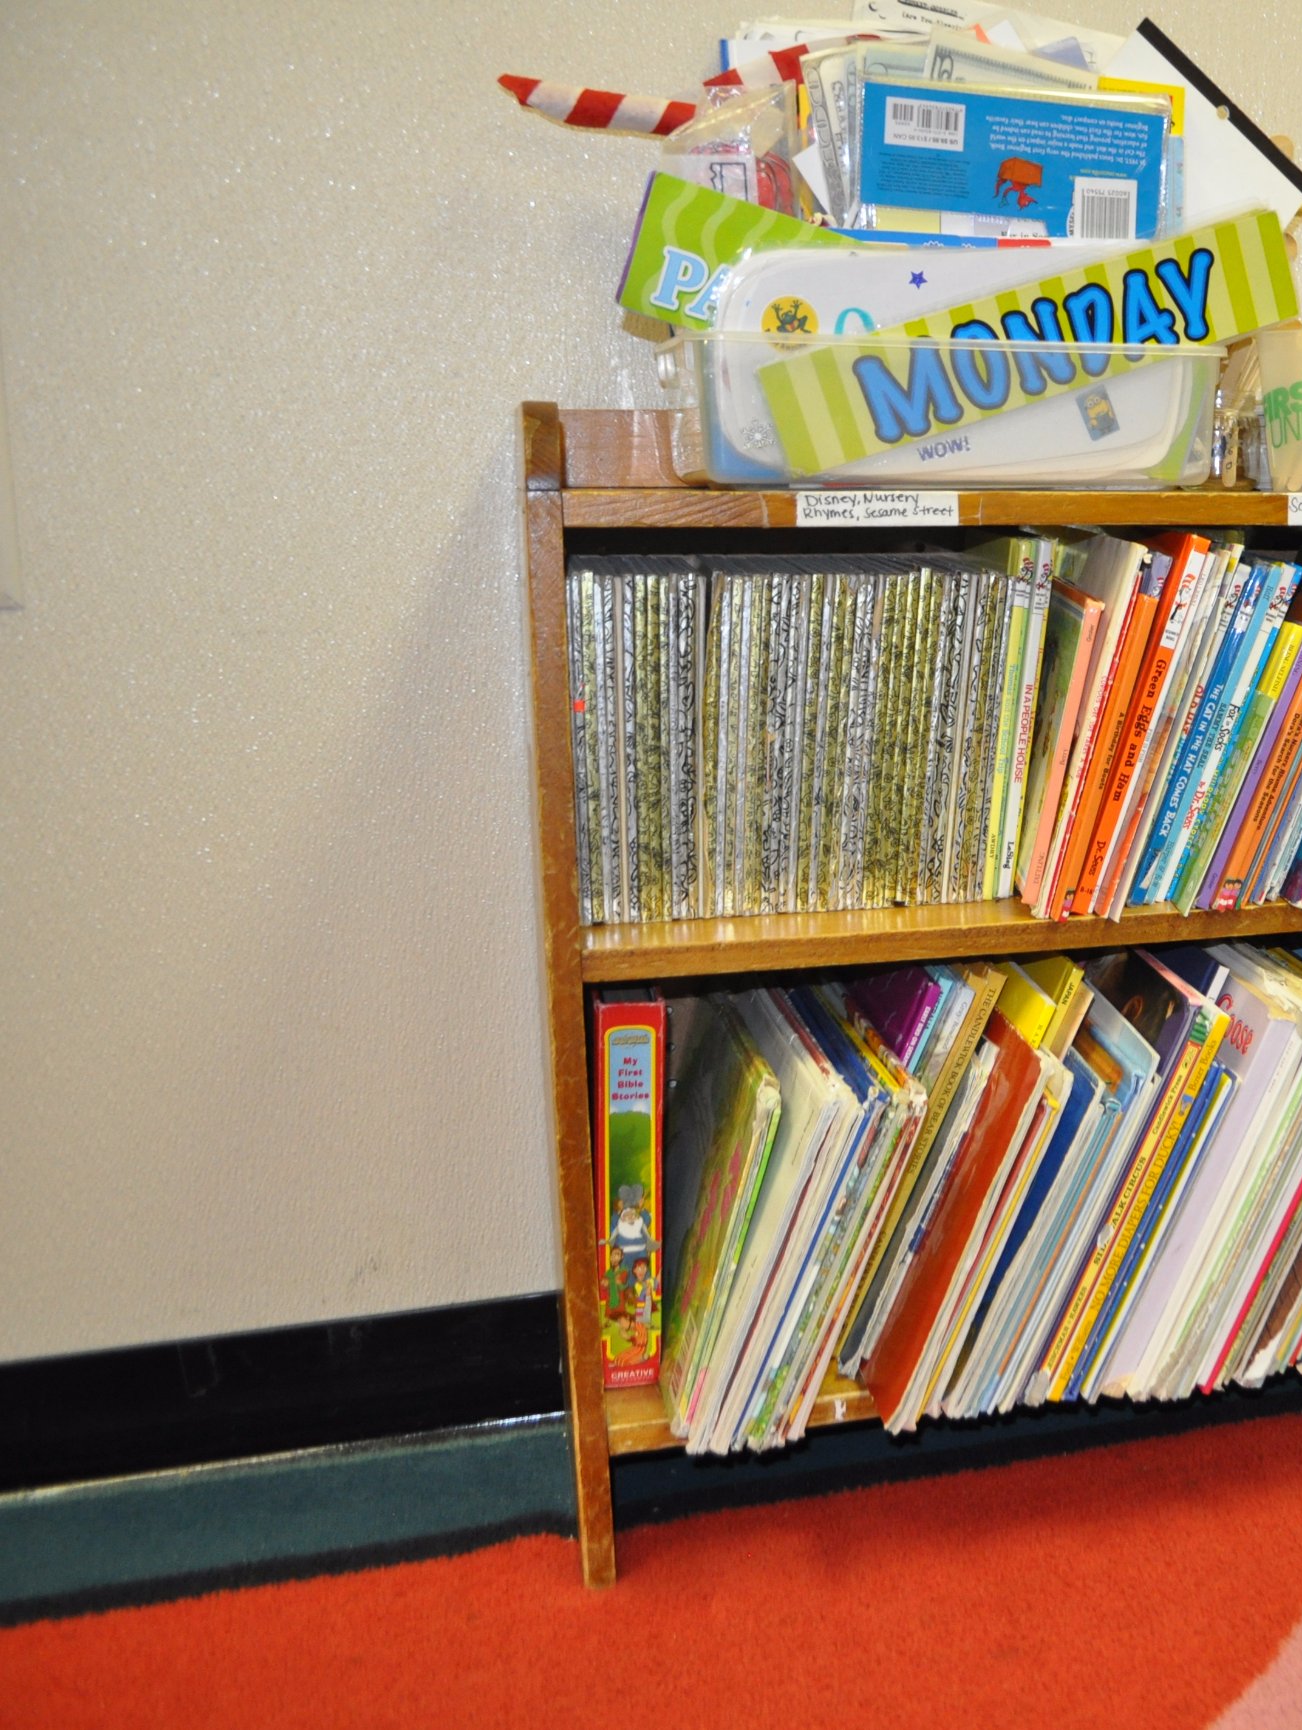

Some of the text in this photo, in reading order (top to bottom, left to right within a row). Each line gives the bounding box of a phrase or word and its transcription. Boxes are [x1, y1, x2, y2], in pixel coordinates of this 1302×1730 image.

[853, 248, 1214, 443] MONDAY
[916, 436, 971, 463] WOW!
[863, 506, 909, 519] Sesame
[912, 504, 955, 518] Street
[1024, 684, 1032, 694] IN
[1144, 658, 1167, 699] Green
[1018, 704, 1030, 745] PEOPLE
[1131, 704, 1152, 738] Eggs
[1224, 703, 1240, 721] Fox
[1108, 719, 1122, 752] Birthday
[1211, 725, 1231, 752] Socks
[1014, 747, 1026, 783] HOUSE
[1104, 754, 1113, 765] for
[1122, 742, 1140, 768] and
[1157, 682, 1224, 837] THE CAT IN THE HAT COMES BACK
[1196, 749, 1209, 770] SEAL
[1280, 738, 1297, 768] Nursery
[1098, 767, 1109, 790] Boots
[1251, 712, 1300, 823] Dora's Search for the Seasons
[1270, 768, 1286, 794] Rhyme
[1110, 771, 1130, 803] Ham
[1192, 788, 1205, 804] Dr.
[1182, 804, 1199, 830] Seuss
[1255, 794, 1276, 831] Adventure
[1003, 840, 1015, 869] LeSieg
[1088, 840, 1105, 877] Dr. Seuss
[1059, 982, 1076, 1006] JAPAN
[617, 1068, 643, 1077] First
[623, 1056, 638, 1066] My
[1187, 1038, 1218, 1091] Boxer Books
[617, 1080, 643, 1089] Bible
[907, 987, 996, 1174] THE CANDLEWICK BOOK OF BEAR STORIES
[611, 1091, 650, 1101] Stories
[1122, 1155, 1148, 1199] CIRCUS
[1089, 1119, 1182, 1311] NO MORE DIAPERS FOR DUCKY!
[610, 1367, 654, 1380] CREATIVE
